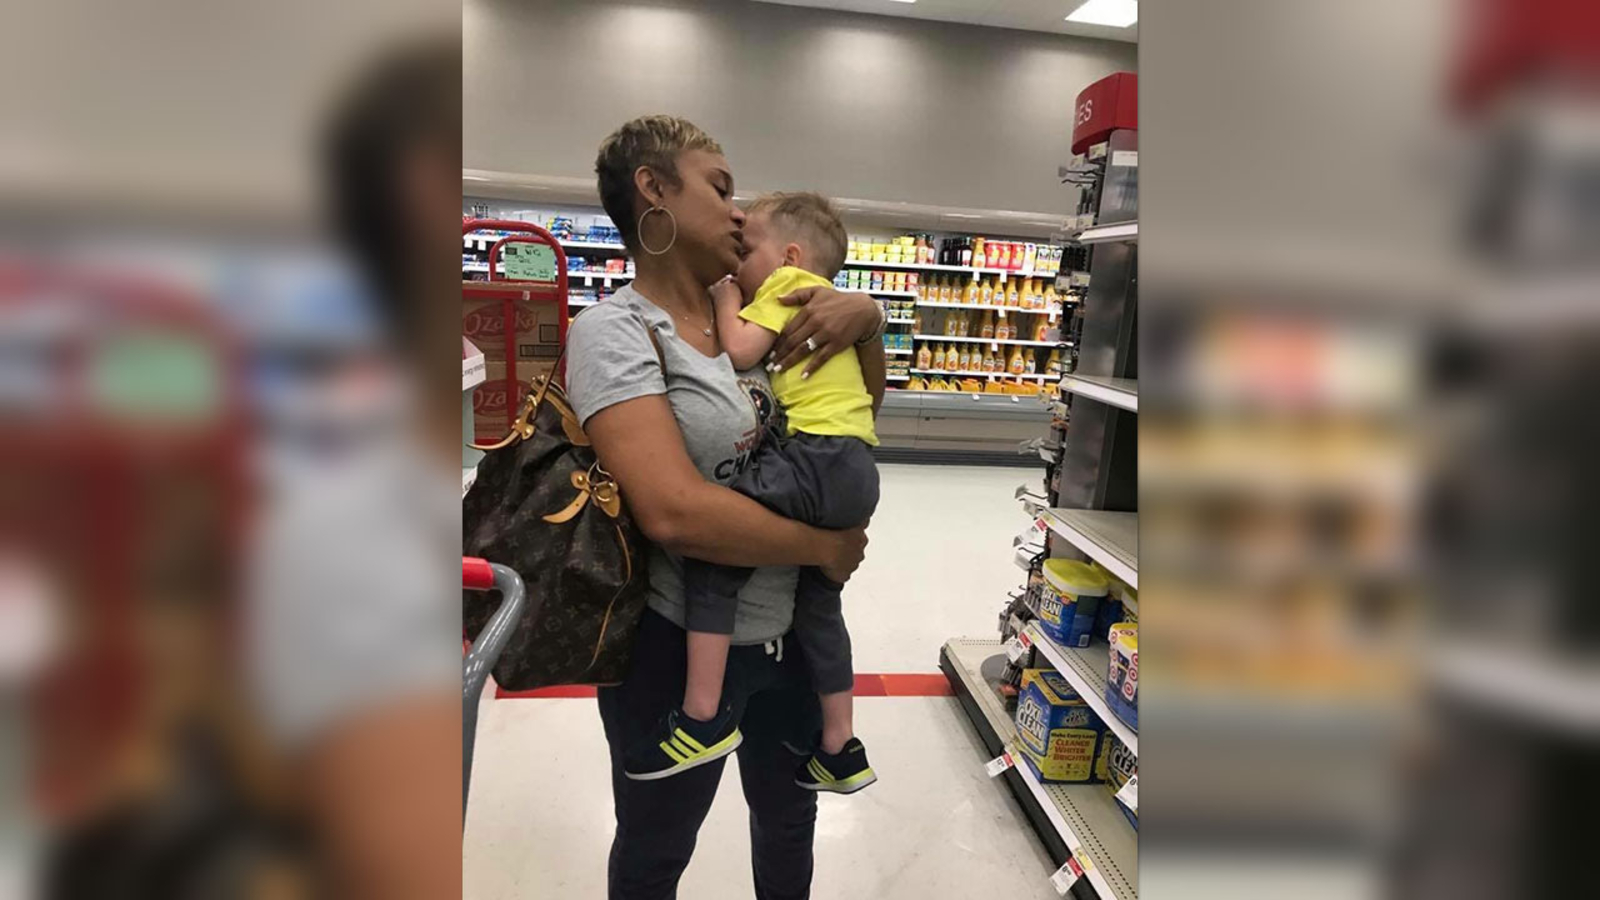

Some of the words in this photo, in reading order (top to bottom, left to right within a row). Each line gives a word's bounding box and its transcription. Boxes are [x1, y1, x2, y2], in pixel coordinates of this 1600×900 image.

[464, 310, 538, 336] Ozaka
[1025, 698, 1041, 722] OXI
[1018, 707, 1044, 739] CLEAN
[1054, 746, 1086, 754] WHITER
[1055, 738, 1091, 747] CLEANER
[1053, 753, 1092, 761] BRIGHTER
